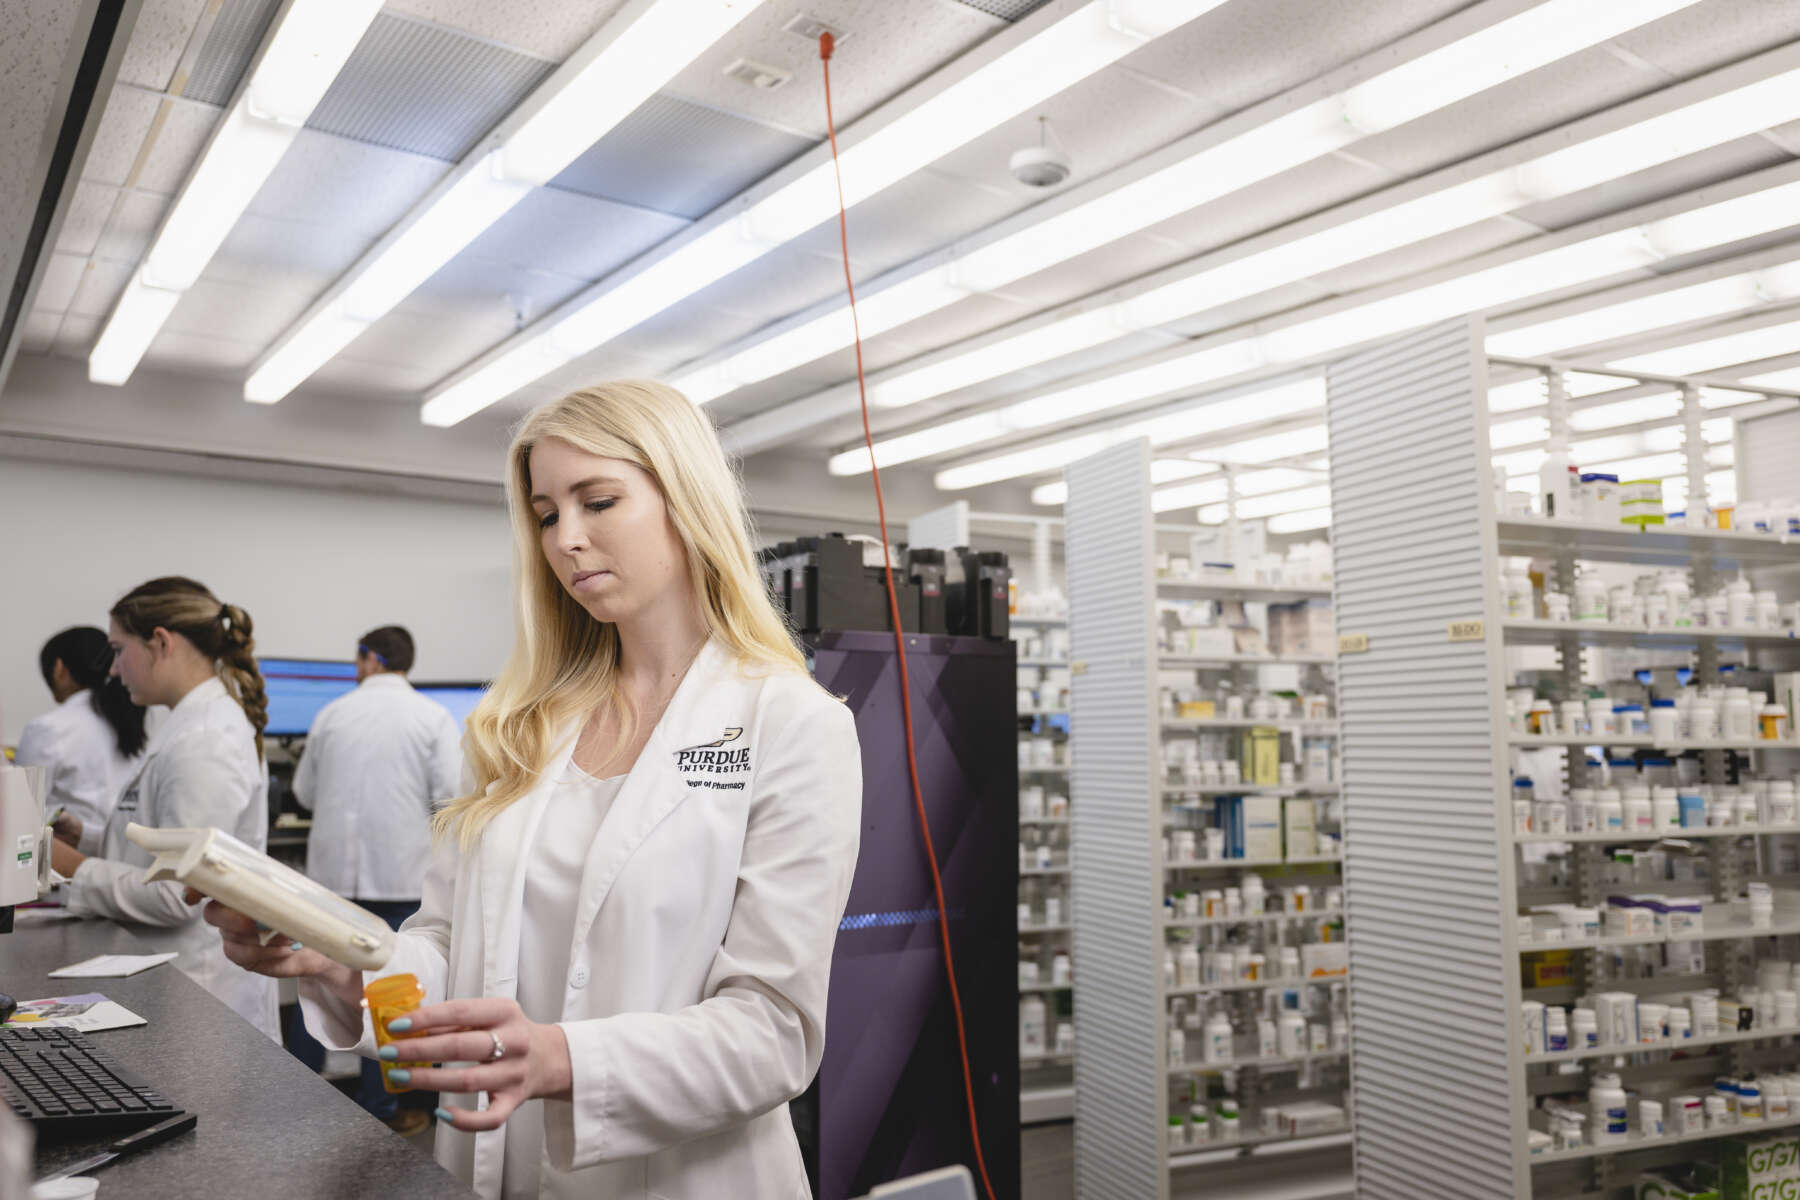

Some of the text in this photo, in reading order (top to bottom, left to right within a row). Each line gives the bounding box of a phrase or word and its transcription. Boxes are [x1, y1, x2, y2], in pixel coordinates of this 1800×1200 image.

[677, 747, 749, 765] PURDUE
[703, 780, 712, 788] of
[711, 781, 746, 791] Pharmacy
